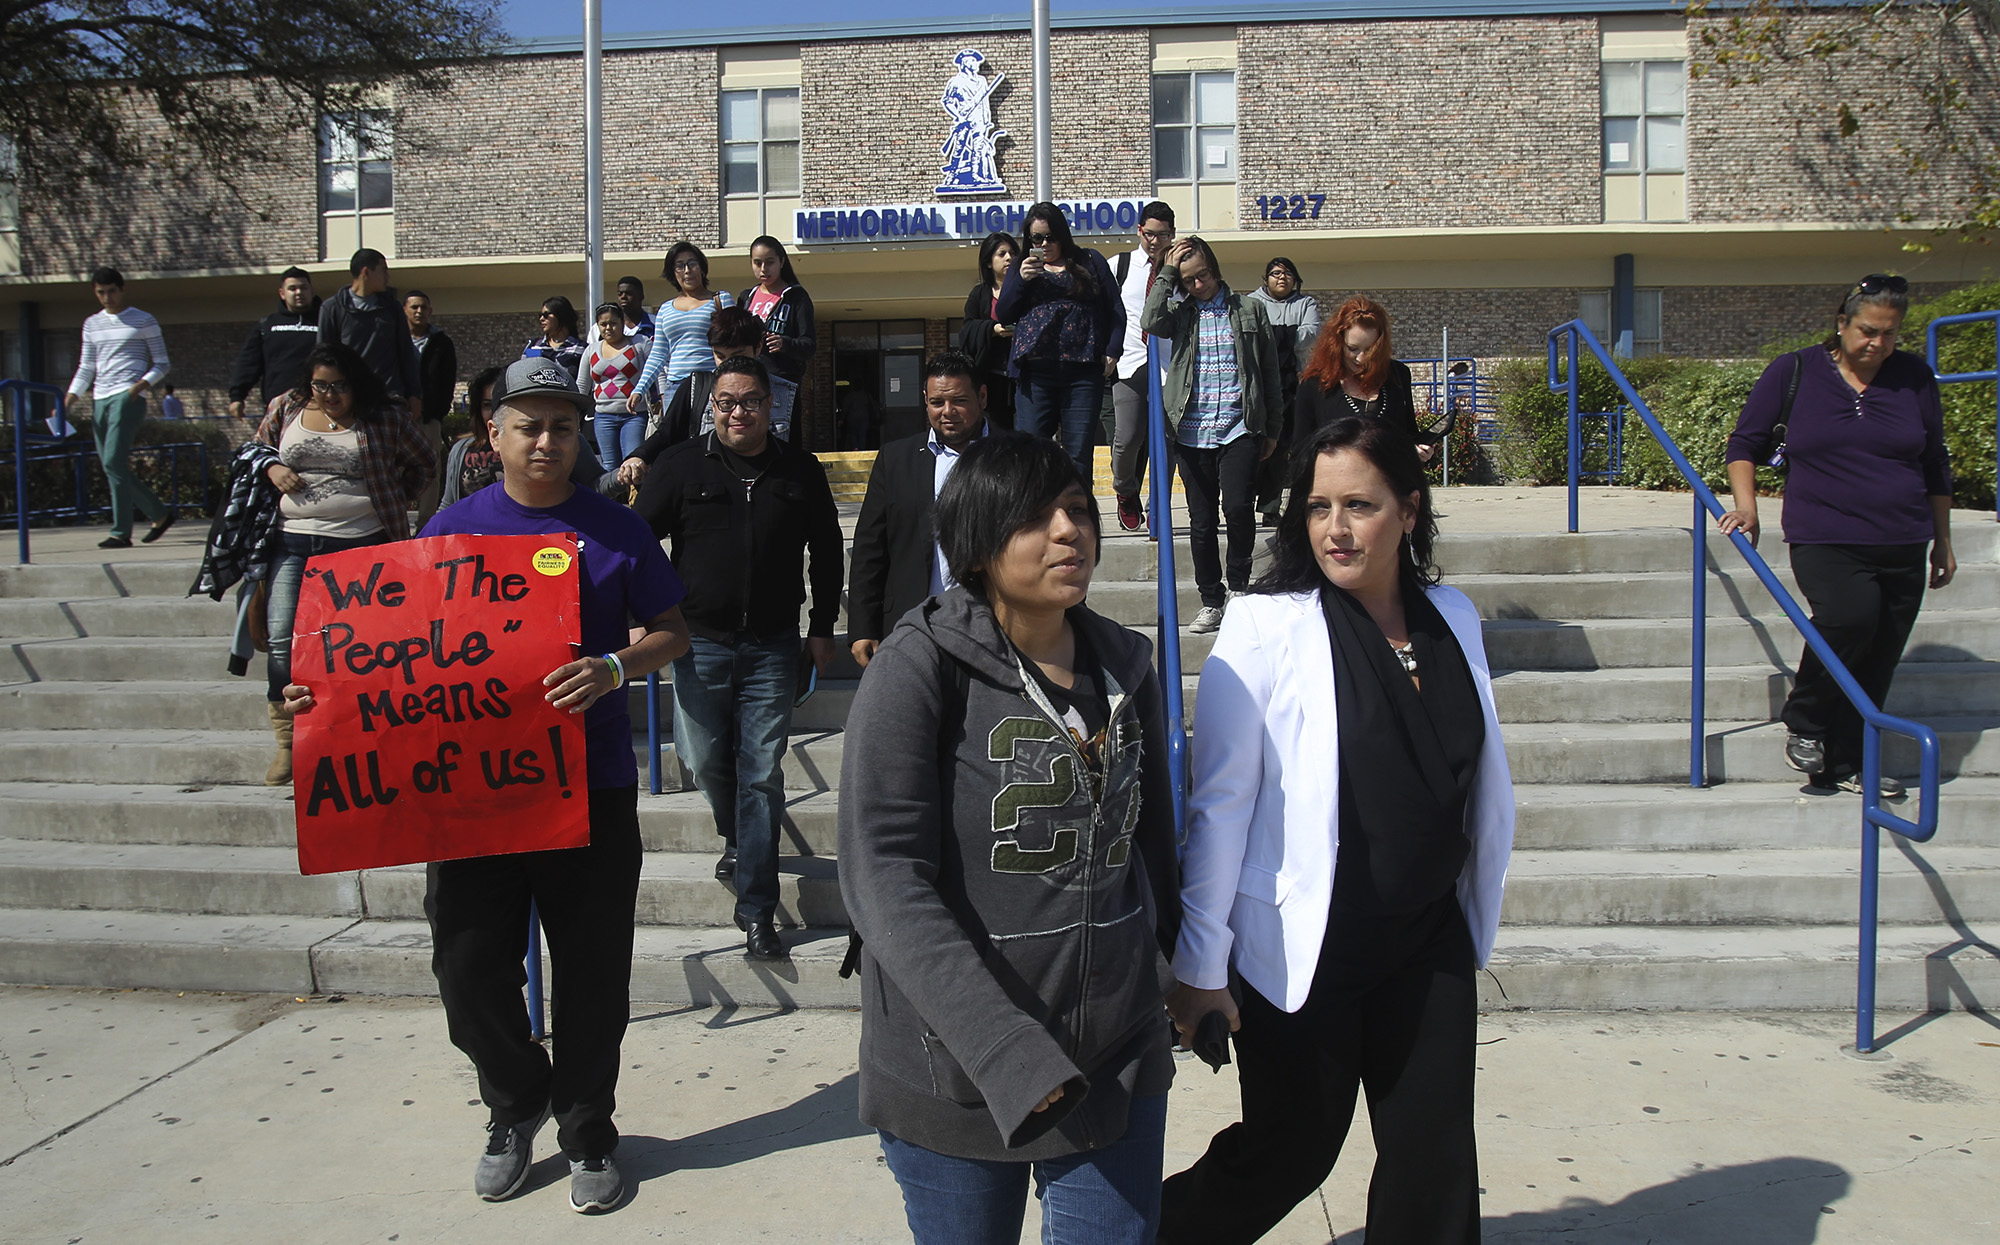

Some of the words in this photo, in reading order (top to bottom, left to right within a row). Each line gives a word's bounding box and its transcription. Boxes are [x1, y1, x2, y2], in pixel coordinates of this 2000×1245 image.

[797, 207, 946, 238] MEMORIAL
[955, 204, 1025, 233] HIGH
[1058, 201, 1144, 230] CHOO
[1256, 194, 1327, 219] 1227
[304, 563, 406, 612] "We
[435, 555, 530, 602] The
[322, 619, 522, 684] People"
[357, 678, 512, 732] Means
[306, 750, 399, 816] All
[412, 741, 462, 794] of
